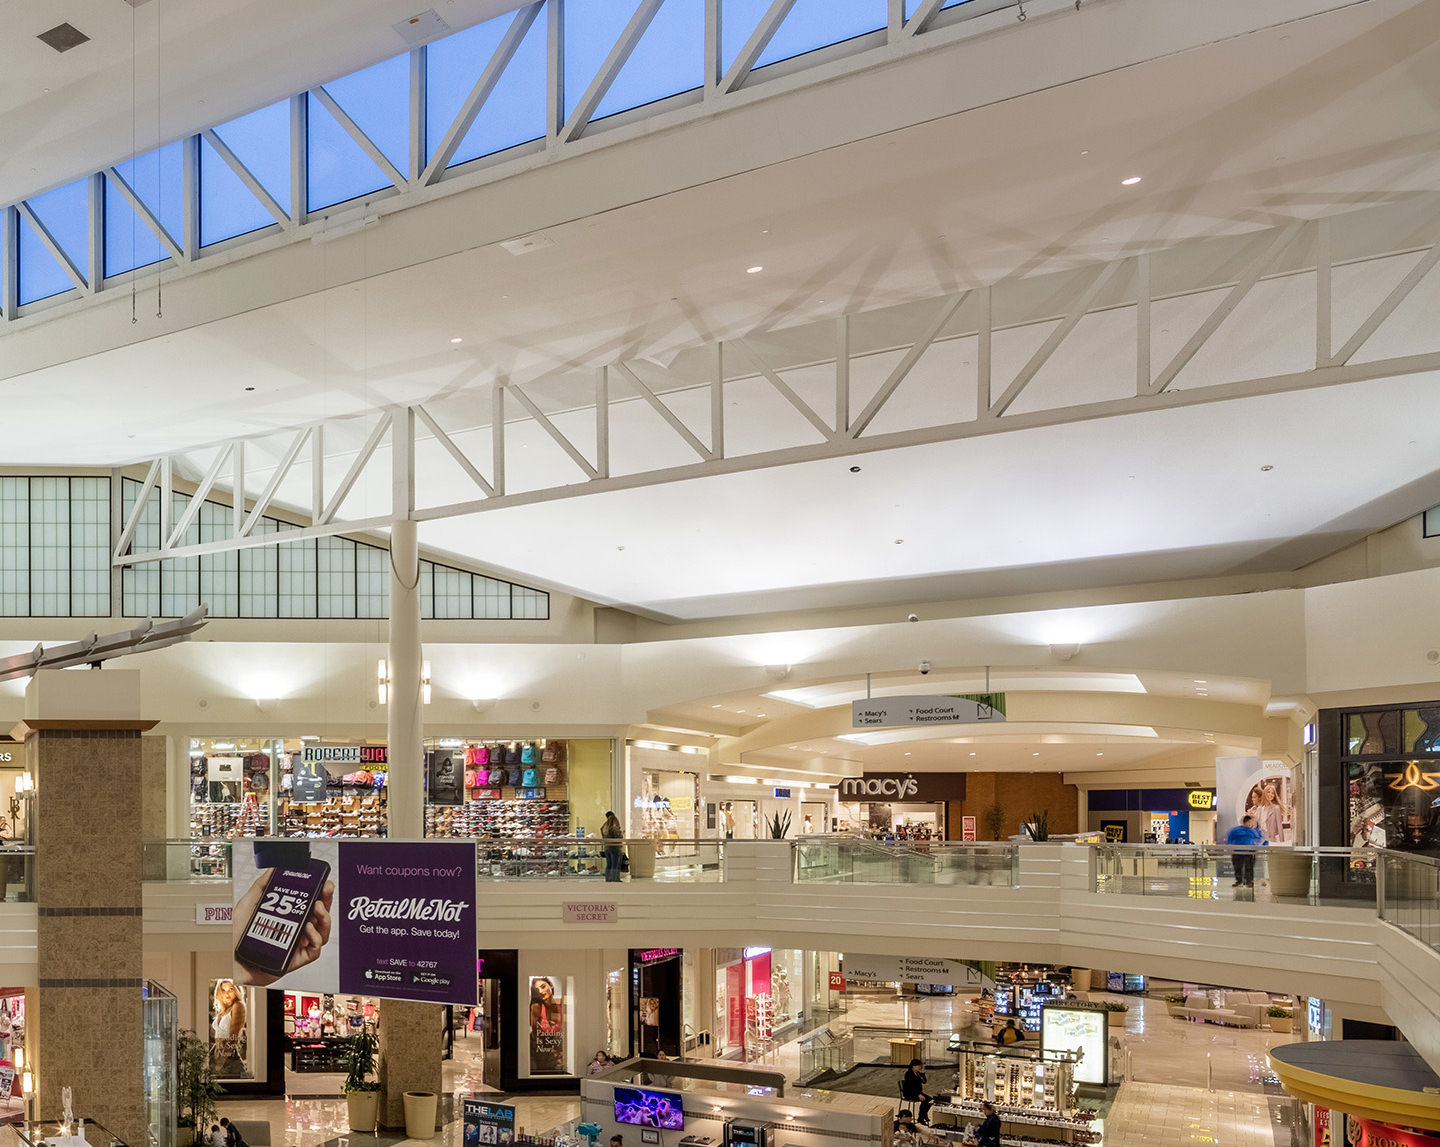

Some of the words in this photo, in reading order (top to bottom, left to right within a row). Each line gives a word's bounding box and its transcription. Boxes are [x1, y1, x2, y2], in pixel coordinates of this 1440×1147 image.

[304, 746, 359, 762] ROBERT
[1191, 793, 1210, 801] BEST
[357, 864, 383, 875] Want
[384, 866, 430, 878] coupons
[432, 866, 462, 877] now?
[273, 886, 290, 895] SAVE
[299, 890, 309, 898] TO
[260, 892, 308, 915] 25%
[567, 904, 615, 912] VICTORIA'S
[205, 907, 233, 921] PIN
[347, 896, 470, 922] RetailMeNot
[576, 913, 608, 921] SECRET
[360, 924, 374, 934] Get
[376, 925, 389, 934] the
[390, 927, 409, 937] app.
[411, 926, 432, 937] Save
[434, 929, 460, 940] today!
[389, 958, 408, 967] SAVE
[417, 960, 438, 969] 42767
[854, 970, 877, 978] Macy's
[905, 966, 941, 974] Restrooms
[374, 974, 387, 982] App
[386, 974, 402, 982] Store
[831, 976, 841, 985] 20
[905, 973, 924, 981] Sears
[1049, 1000, 1100, 1009] DIRECTORY
[545, 1036, 561, 1047] Sexy
